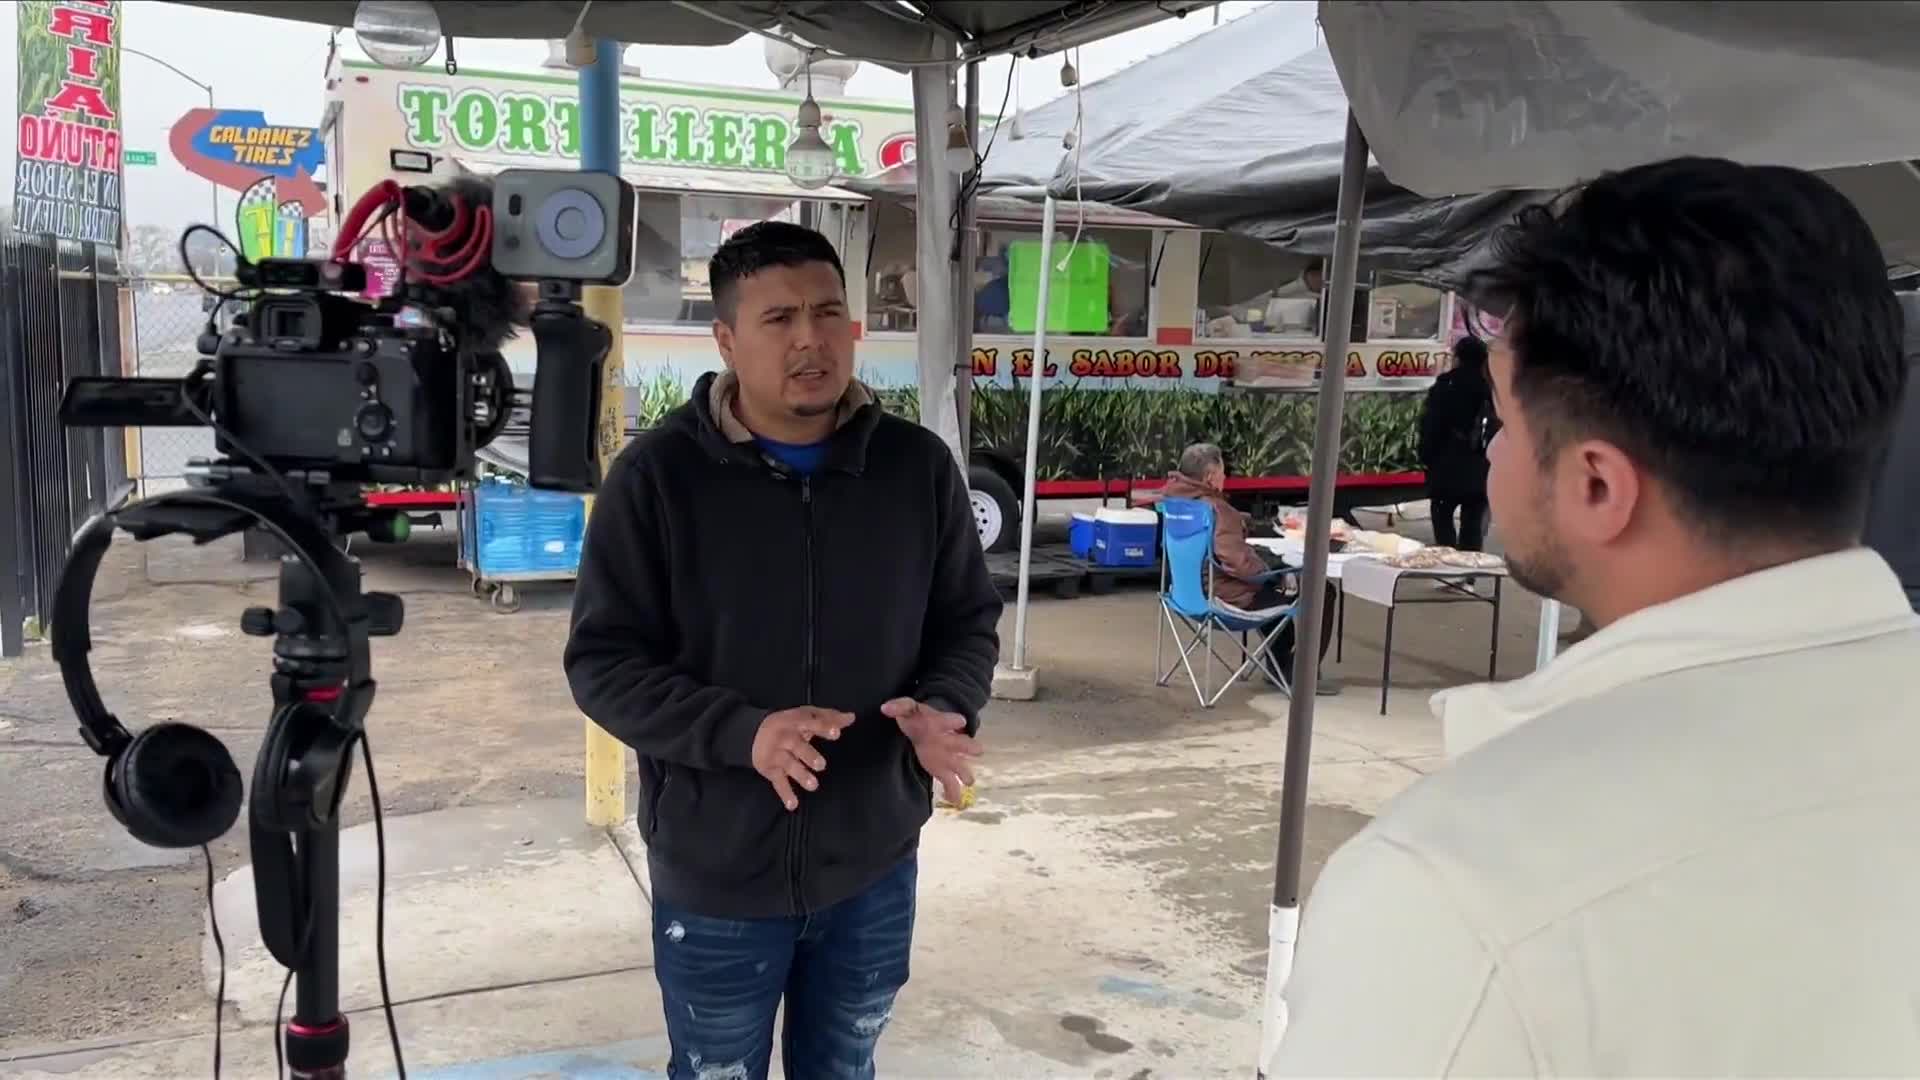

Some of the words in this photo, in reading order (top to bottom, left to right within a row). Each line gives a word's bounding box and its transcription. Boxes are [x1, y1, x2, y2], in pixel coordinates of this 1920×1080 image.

[400, 88, 865, 177] TORTLLERA
[232, 145, 296, 165] TIRES
[1012, 349, 1057, 377] EL
[1070, 349, 1182, 377] SABOR
[1194, 350, 1239, 377] DE
[1377, 350, 1455, 377] CALI
